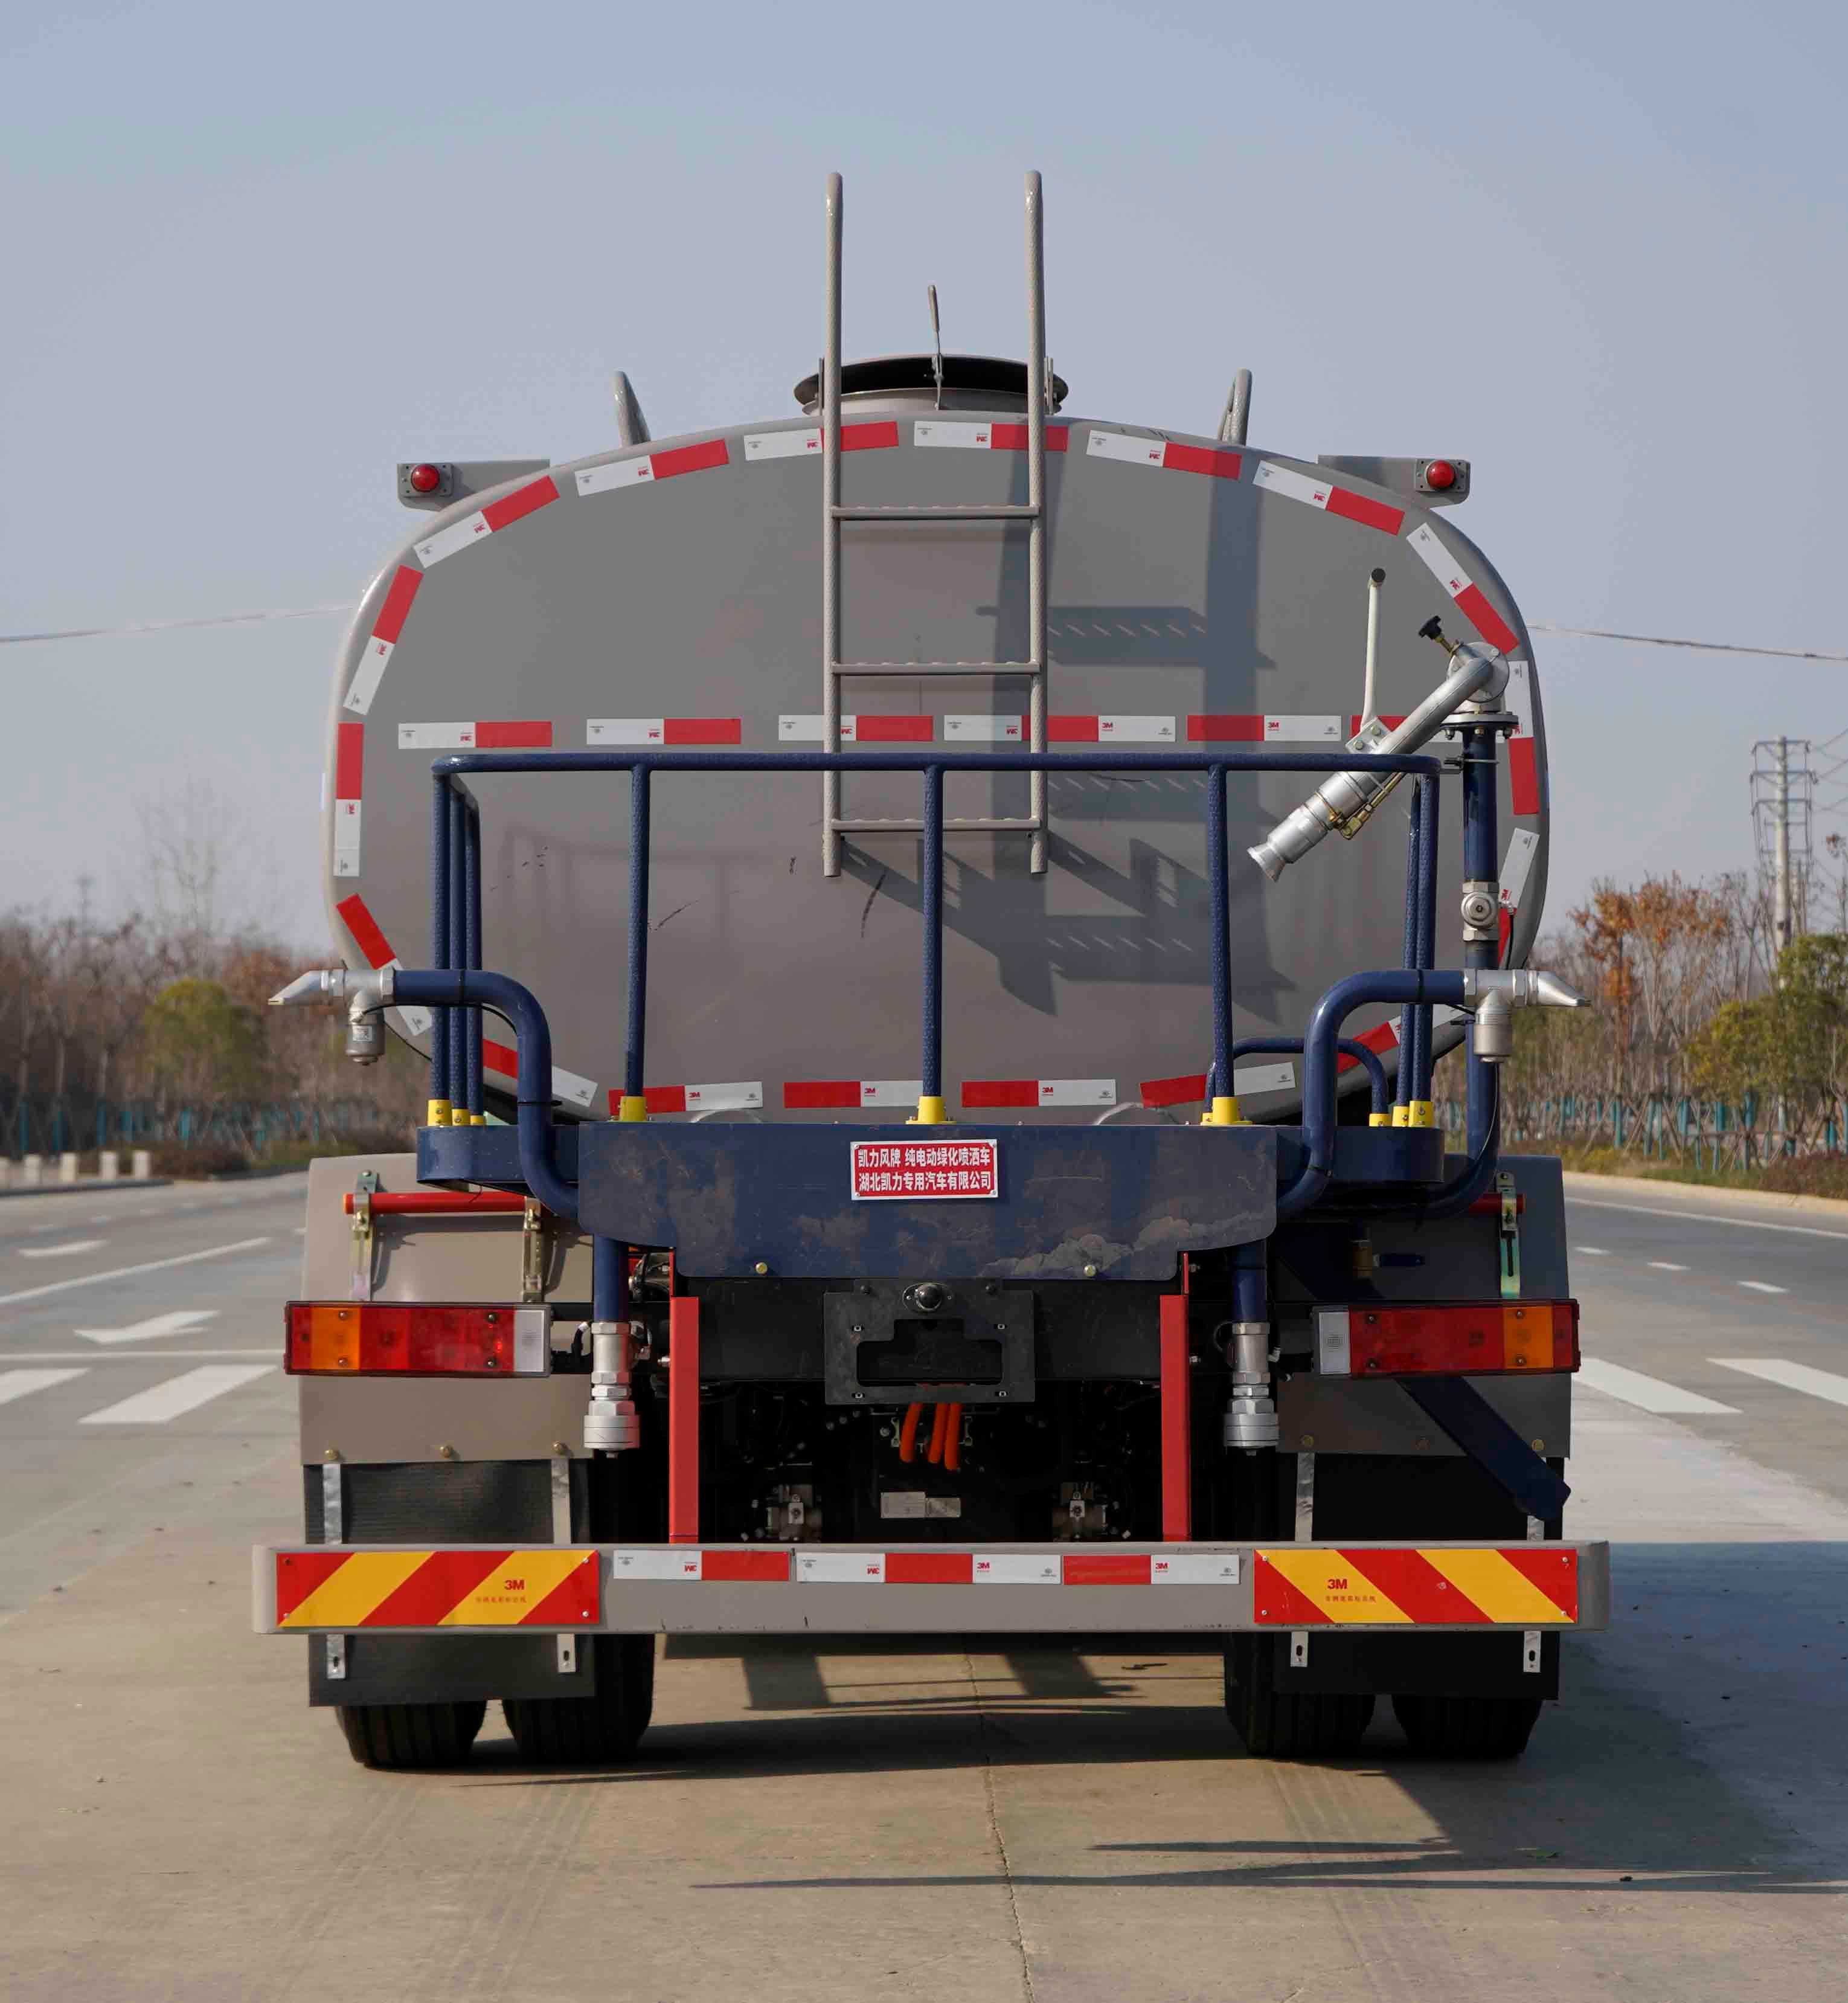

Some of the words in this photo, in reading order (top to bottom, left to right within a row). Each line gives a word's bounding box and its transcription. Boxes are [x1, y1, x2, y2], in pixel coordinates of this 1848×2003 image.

[858, 1148, 900, 1168] 凯力风牌
[905, 1146, 990, 1167] 纯电动绿化喷洒车
[858, 1171, 991, 1192] 湖北凯力专用汽车有限公司
[504, 1580, 525, 1590] 3M
[1327, 1578, 1348, 1590] 3M
